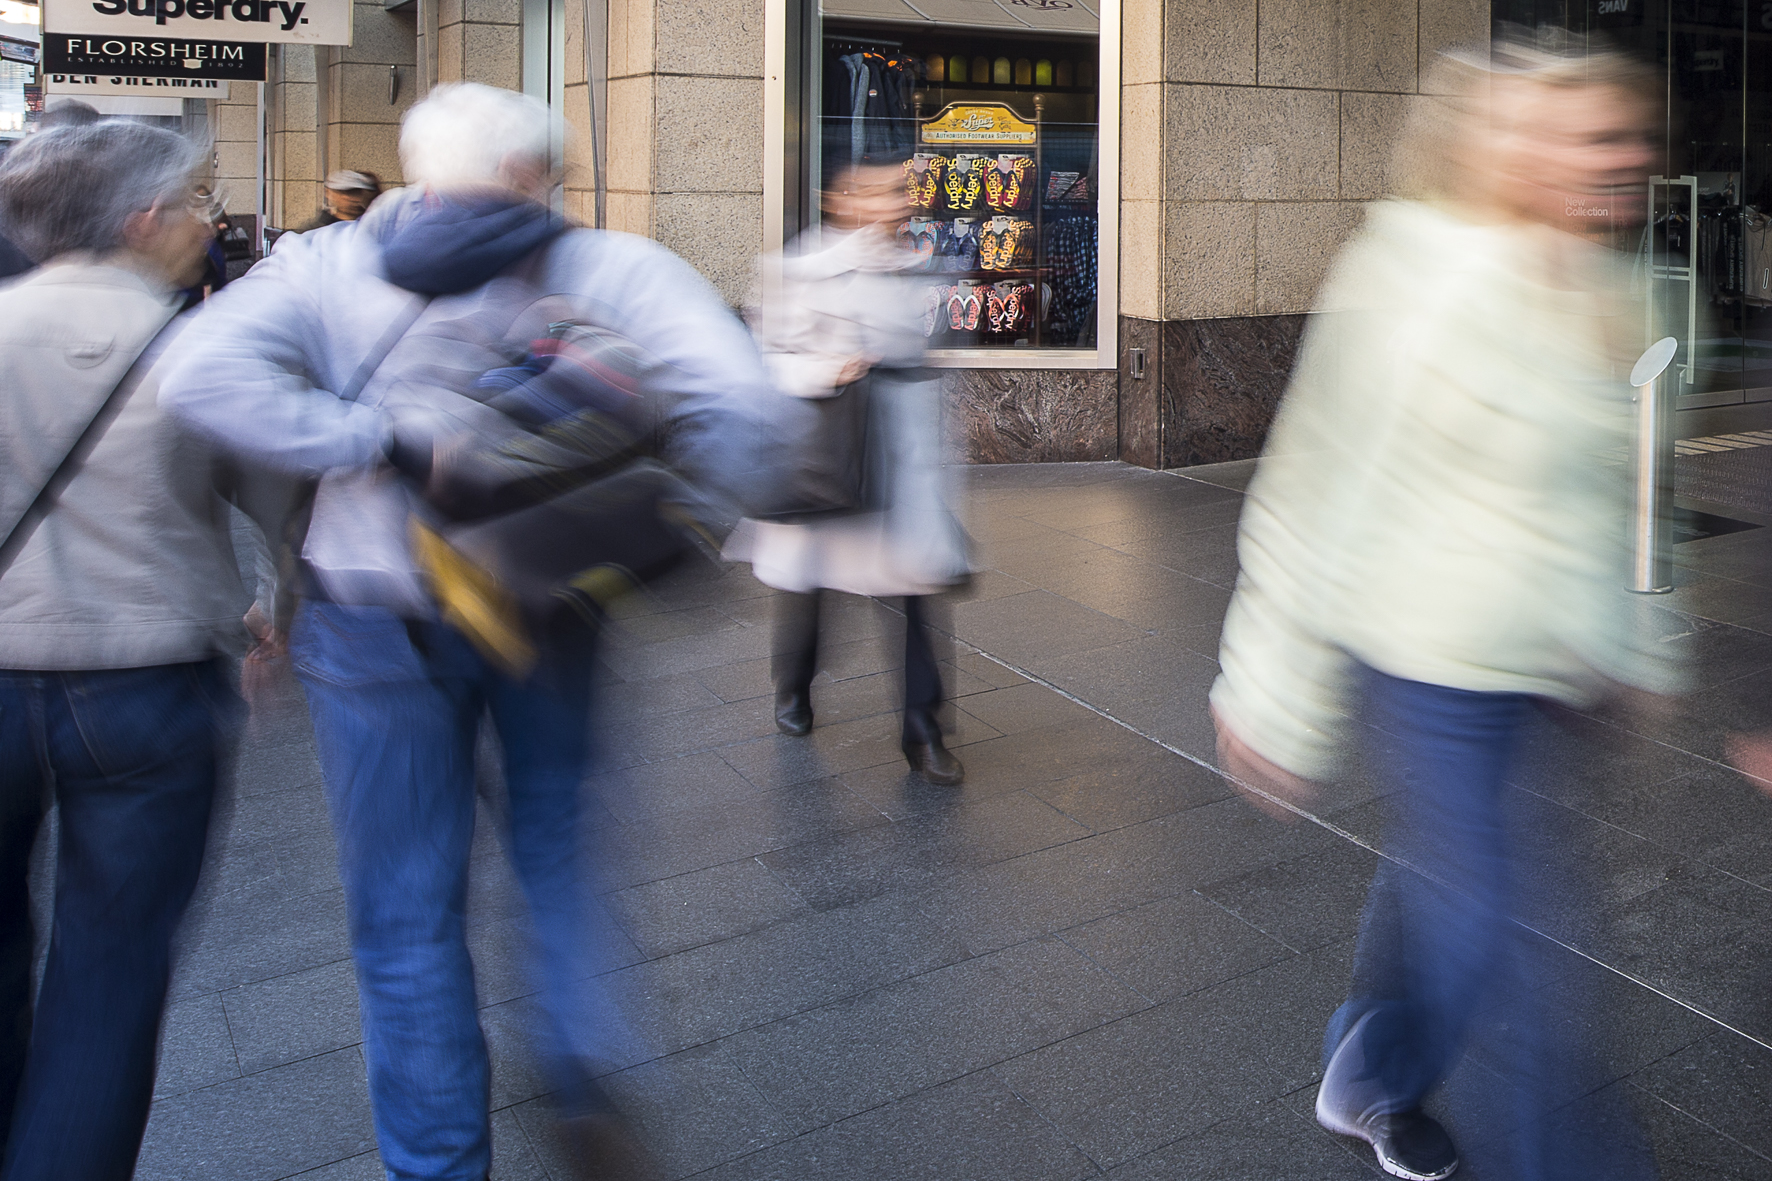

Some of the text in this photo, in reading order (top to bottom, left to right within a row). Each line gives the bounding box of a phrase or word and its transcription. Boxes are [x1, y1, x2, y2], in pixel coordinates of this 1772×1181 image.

[67, 38, 245, 61] FLORSHEIM
[67, 56, 244, 69] ESTABLISHED 1892
